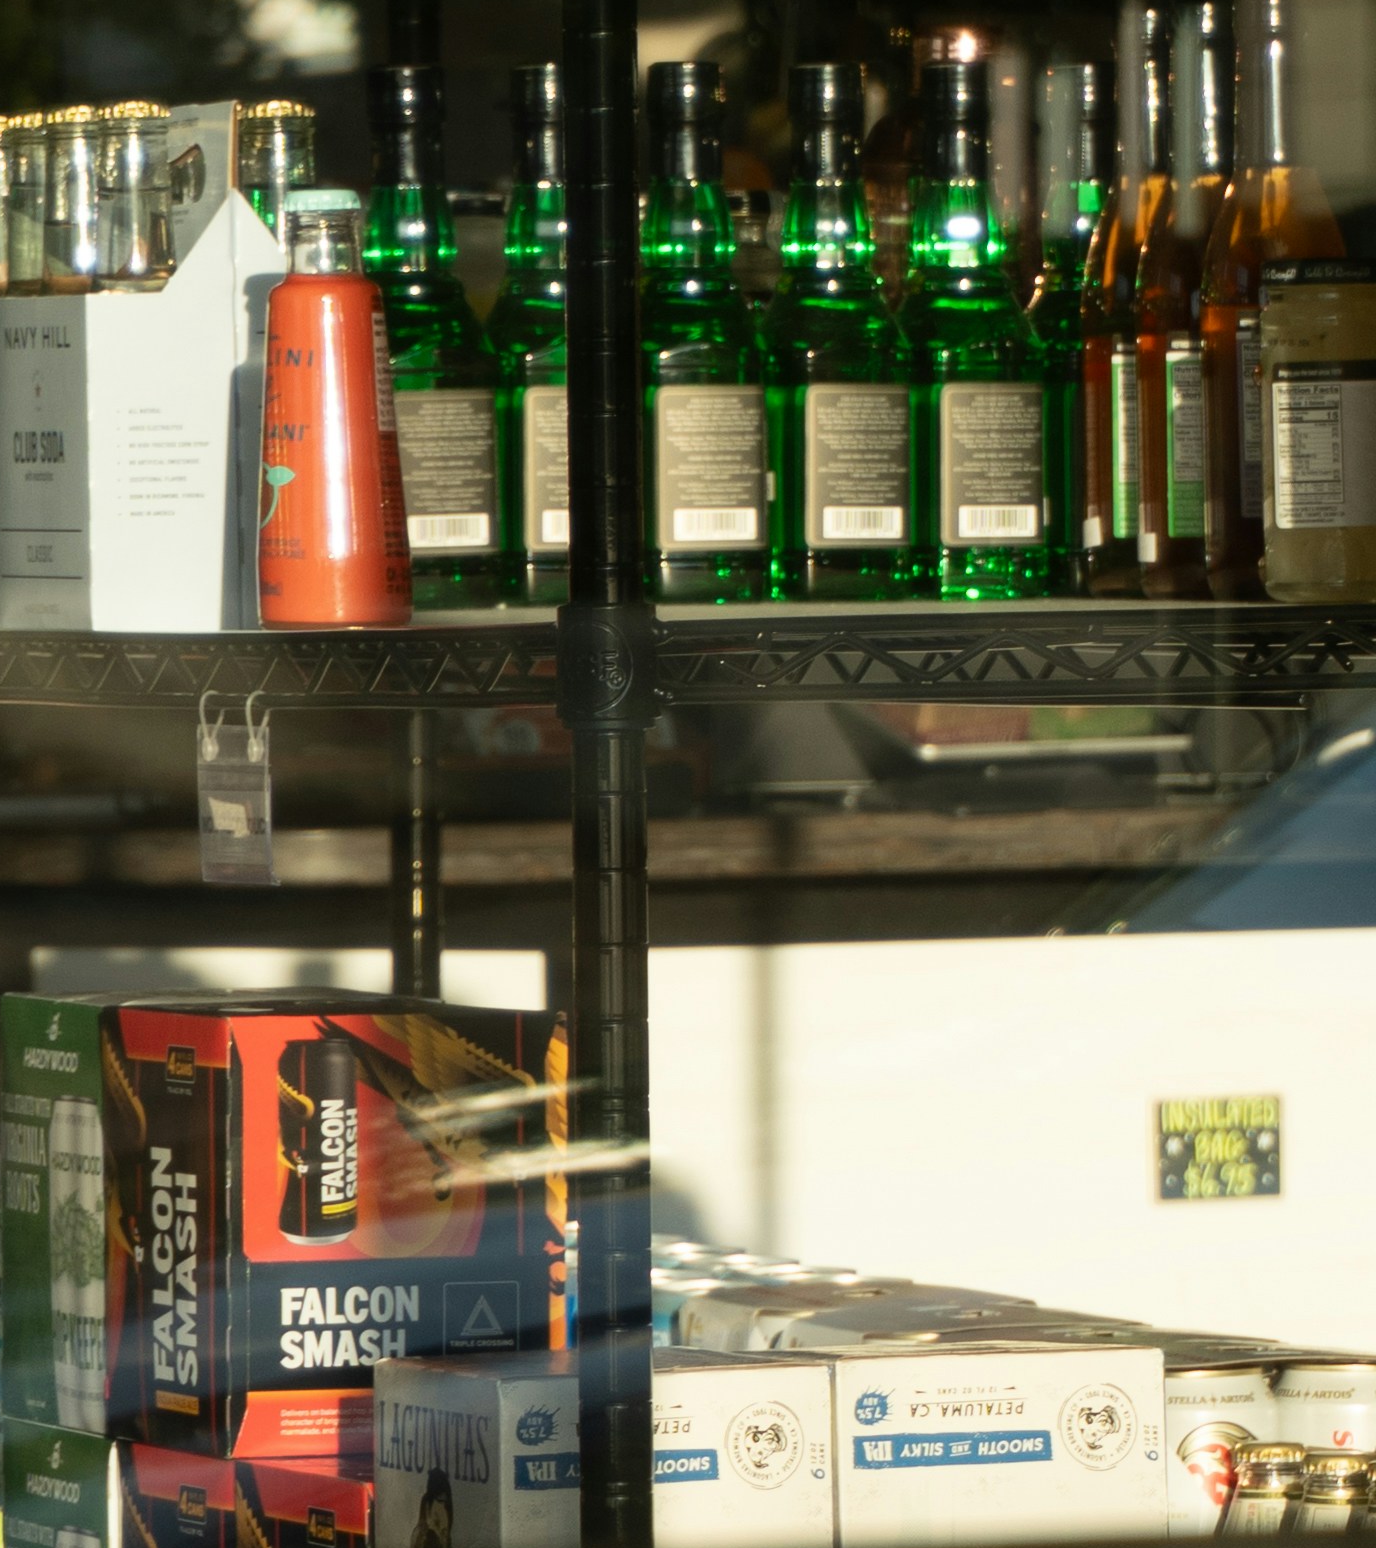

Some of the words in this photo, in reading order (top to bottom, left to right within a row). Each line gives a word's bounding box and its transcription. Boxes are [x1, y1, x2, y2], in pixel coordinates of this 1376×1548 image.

[4, 326, 37, 350] NAVY
[42, 326, 71, 348] HILL
[13, 430, 37, 463] CLUB
[40, 430, 65, 463] SODA
[22, 1046, 80, 1074] HARDYWOOD
[320, 1099, 345, 1203] FALCON
[344, 1107, 358, 1200] SMASH
[150, 1145, 175, 1382] FALCON
[175, 1172, 198, 1387] SMASH
[280, 1285, 420, 1326] FALCON
[279, 1328, 406, 1370] SMASH
[909, 1403, 931, 1418] CA
[936, 1400, 1025, 1418] PETALUMA,
[1167, 1395, 1207, 1405] STELLA
[280, 1418, 314, 1428] character
[857, 1406, 883, 1420] 7.5%
[379, 1400, 491, 1484] LAGUNITAS
[863, 1440, 893, 1462] IPA
[900, 1441, 945, 1458] SILKY
[951, 1444, 970, 1455] AND
[978, 1437, 1045, 1455] SMOOTH
[1144, 1449, 1159, 1462] 6
[526, 1460, 557, 1482] IPA
[811, 1468, 826, 1480] 6
